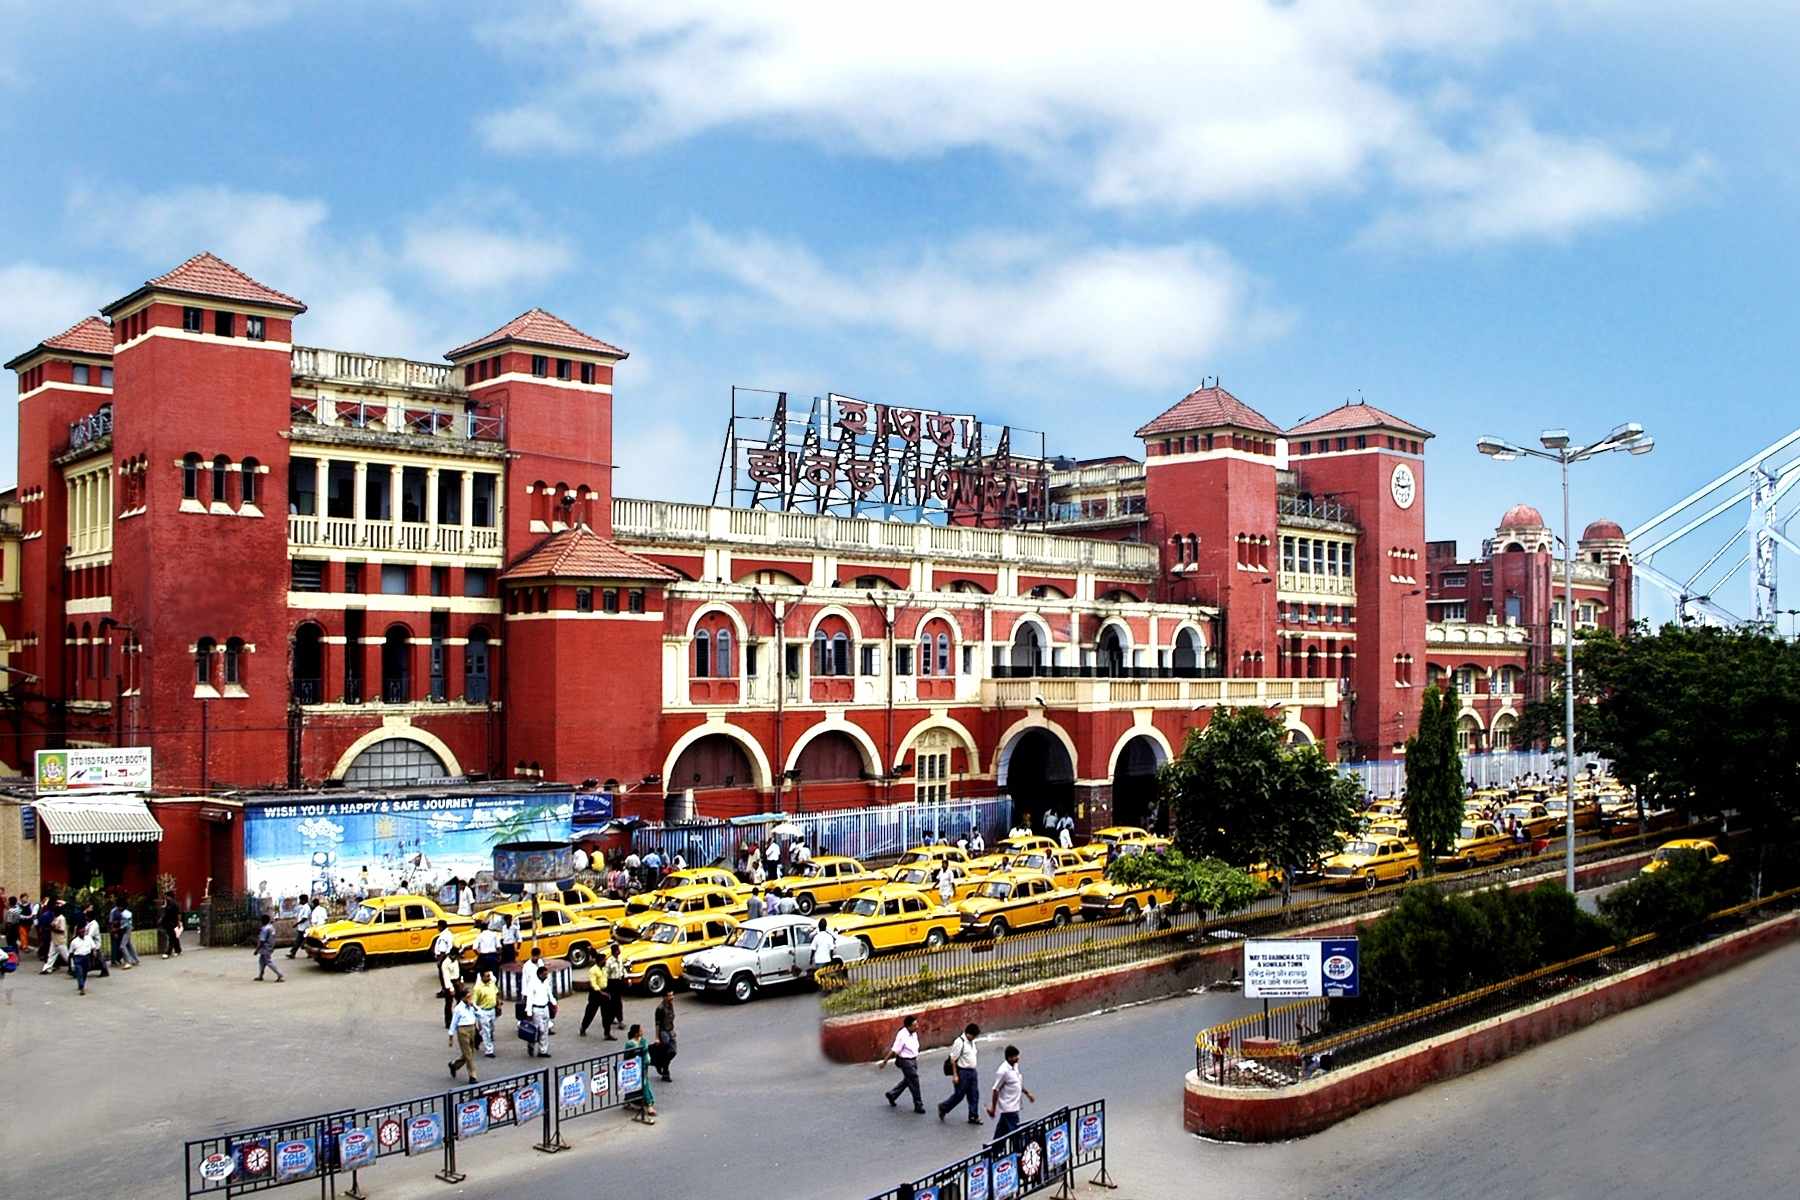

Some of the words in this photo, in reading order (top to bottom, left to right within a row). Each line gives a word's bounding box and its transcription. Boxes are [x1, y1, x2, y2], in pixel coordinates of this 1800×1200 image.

[914, 465, 1042, 514] HOWRAH
[264, 806, 297, 818] WISH
[301, 805, 325, 816] YOU
[328, 804, 337, 815] A
[340, 802, 378, 814] HAPPY
[380, 801, 389, 812] &
[393, 800, 419, 811] SAFE
[423, 798, 474, 810] JOURNEY
